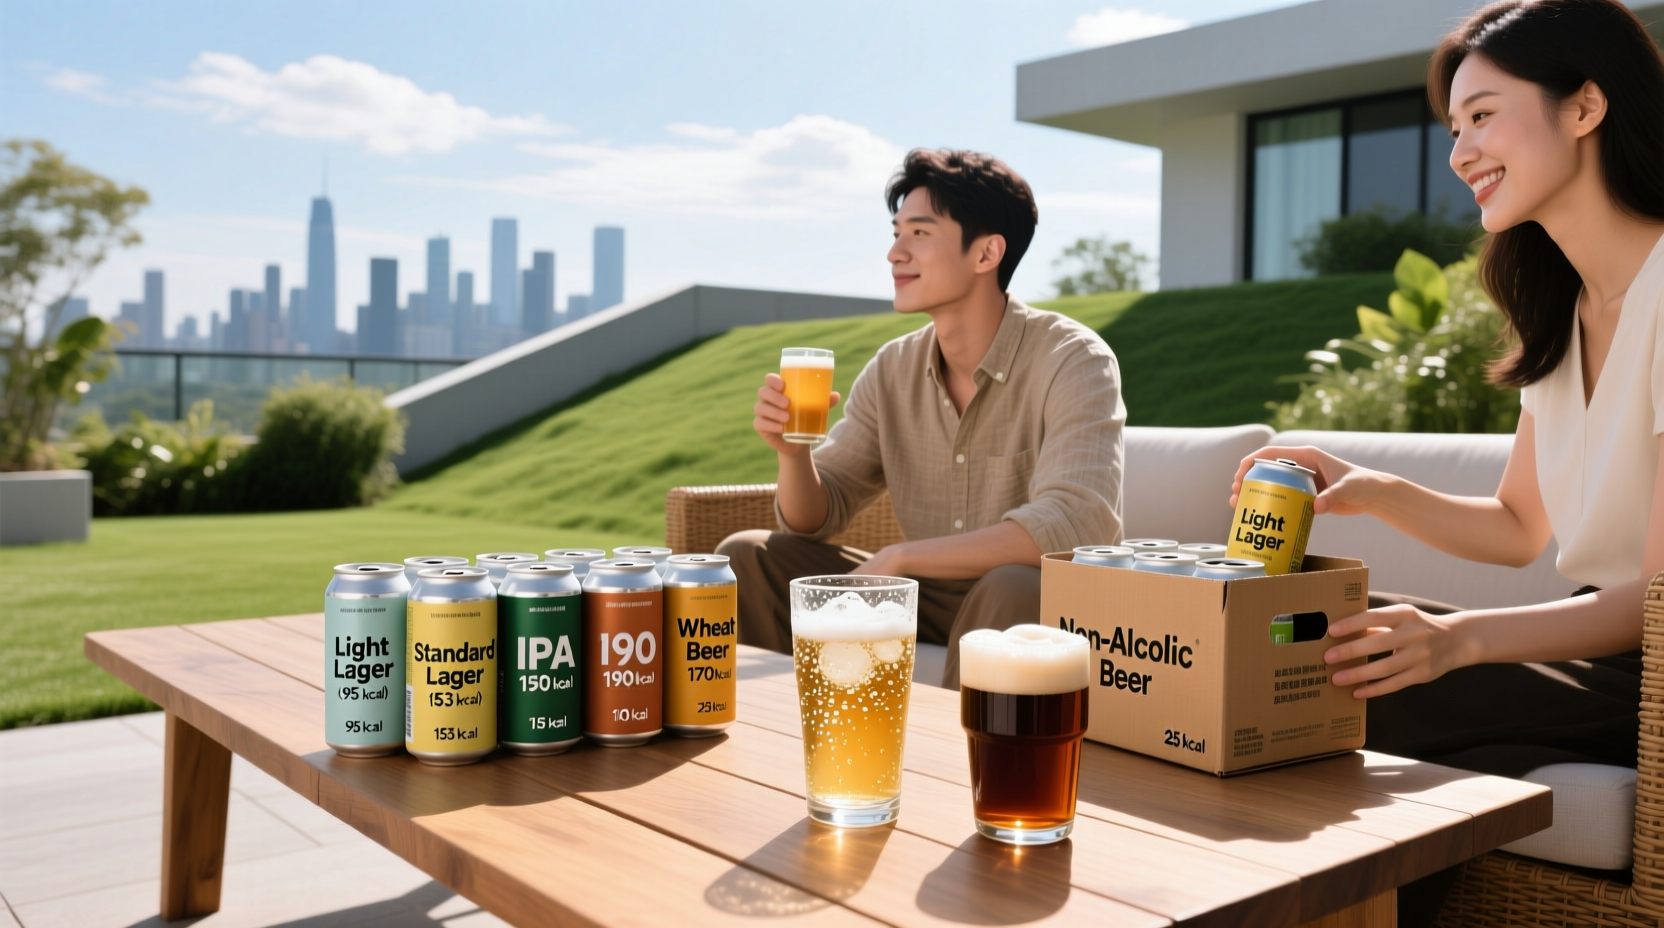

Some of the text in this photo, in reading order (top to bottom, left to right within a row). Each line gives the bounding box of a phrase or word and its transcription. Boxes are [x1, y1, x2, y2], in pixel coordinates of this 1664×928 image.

[1241, 508, 1285, 532] Light
[1236, 527, 1285, 551] Lager
[677, 616, 736, 638] Wheat
[335, 636, 389, 662] Light
[414, 638, 495, 663] Standard
[517, 635, 575, 670] IPA
[686, 641, 730, 661] Beer
[334, 659, 394, 684] Lager
[426, 666, 484, 690] Lager
[519, 674, 551, 692] 150
[603, 670, 634, 688] 190
[687, 666, 714, 682] 170
[1100, 658, 1152, 695] Beer
[338, 685, 388, 700] (95 kcal)
[456, 690, 482, 706] kcal)
[345, 720, 361, 733] 95
[529, 716, 546, 730] 15
[1164, 729, 1205, 754] 25 kcal
